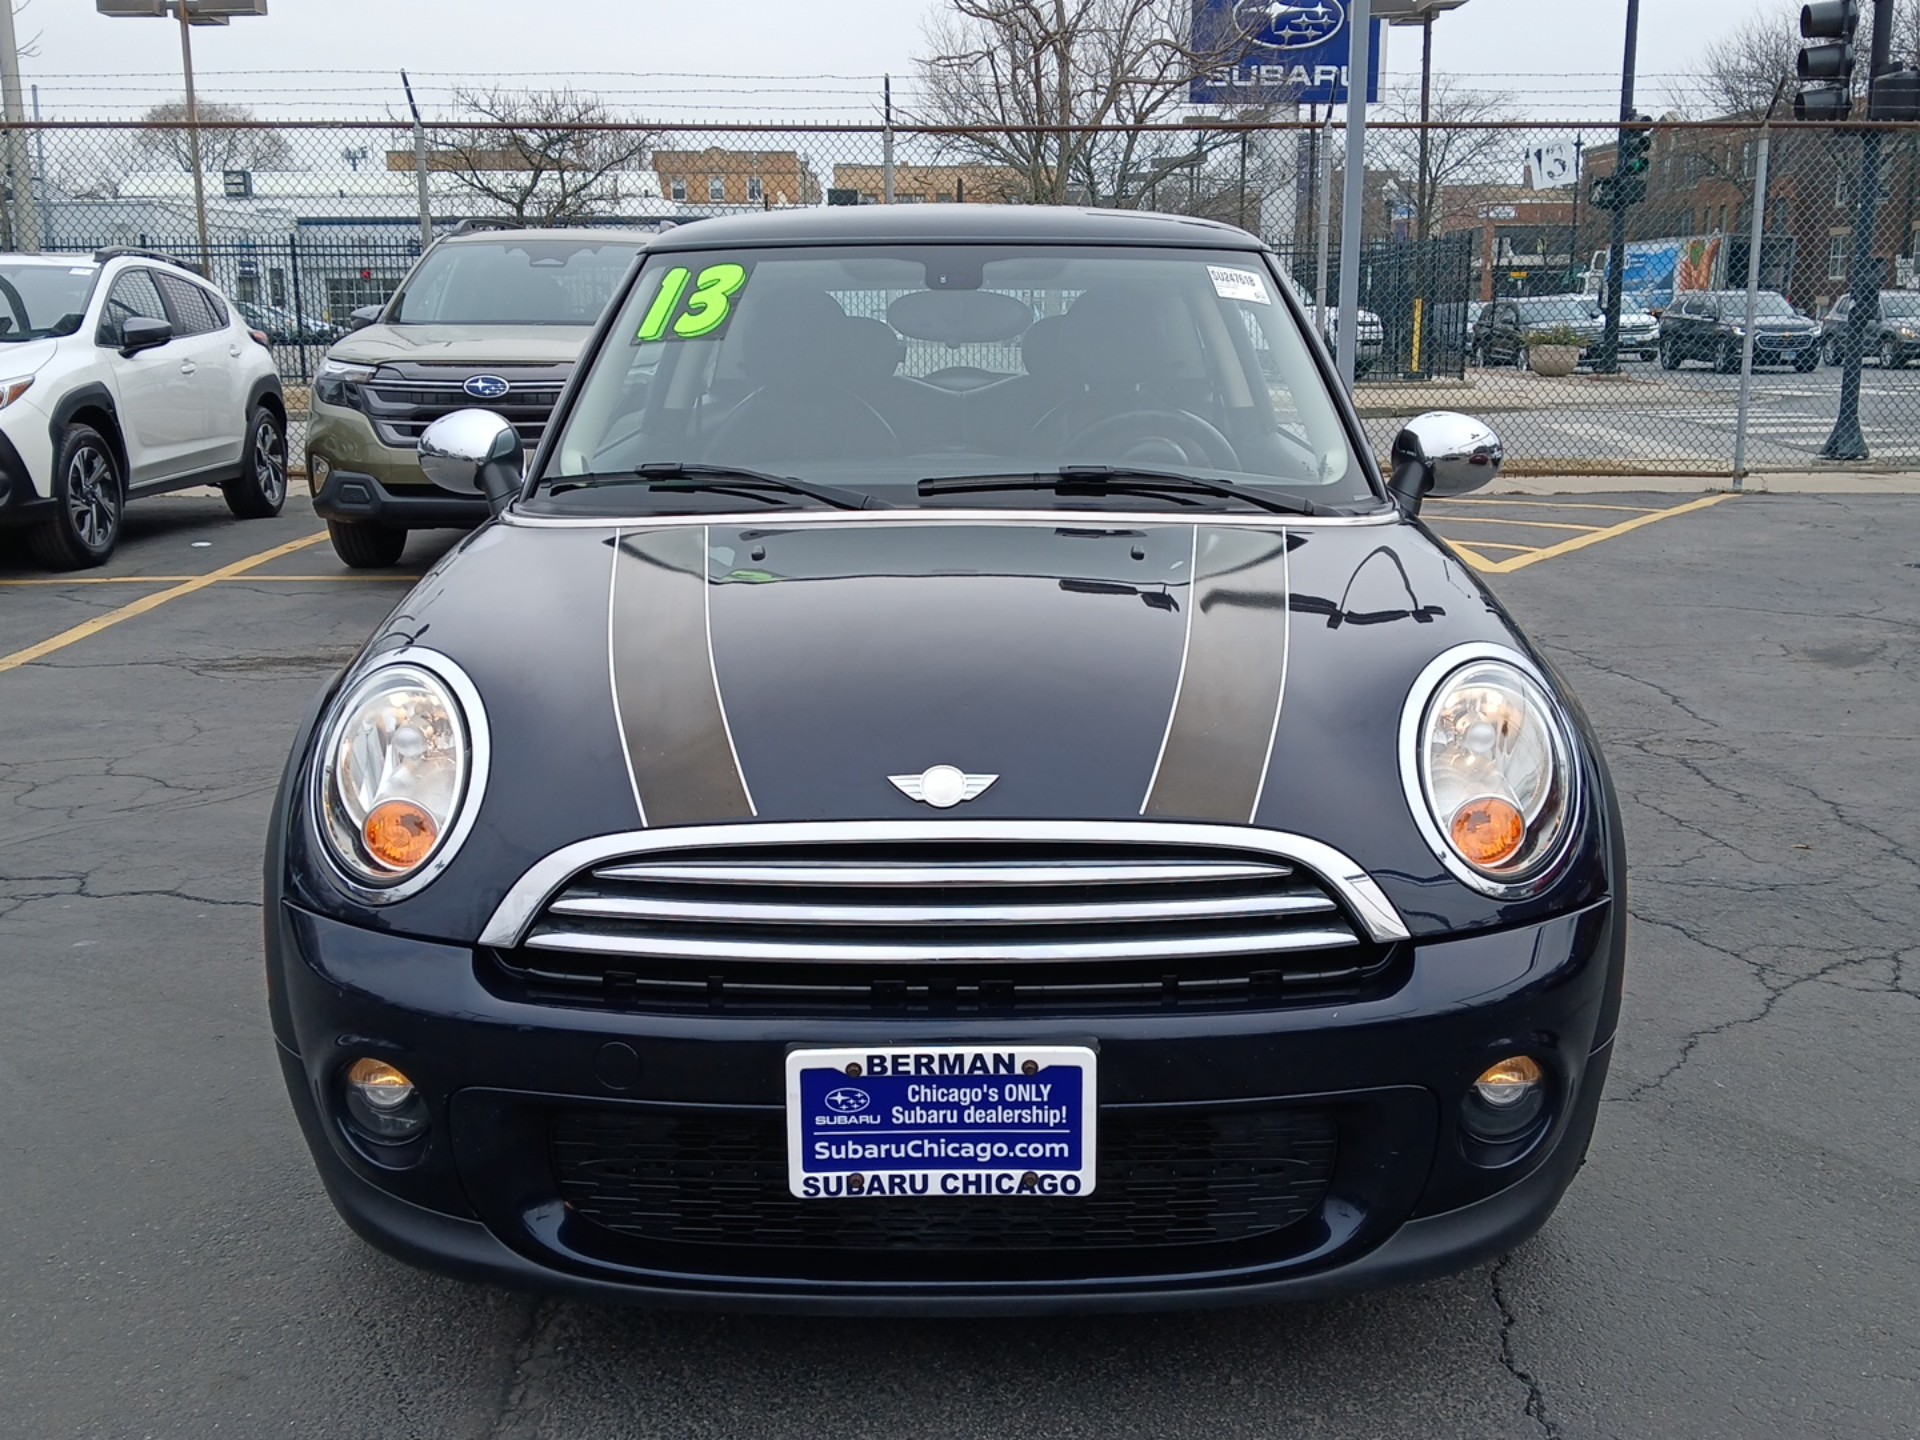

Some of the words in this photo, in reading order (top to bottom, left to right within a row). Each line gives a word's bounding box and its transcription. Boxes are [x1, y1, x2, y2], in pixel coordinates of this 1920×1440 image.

[636, 263, 747, 342] 13
[866, 1053, 1016, 1076] BERMAN
[907, 1084, 999, 1106] Chicago's
[1004, 1084, 1052, 1102] ONLY
[815, 1115, 881, 1125] SUBARU
[891, 1106, 958, 1124] Subaru
[963, 1105, 1067, 1127] dealership!
[814, 1138, 1070, 1162] SubaruChicago.com
[802, 1174, 930, 1197] SUBARU
[940, 1173, 1081, 1195] CHICAGO
